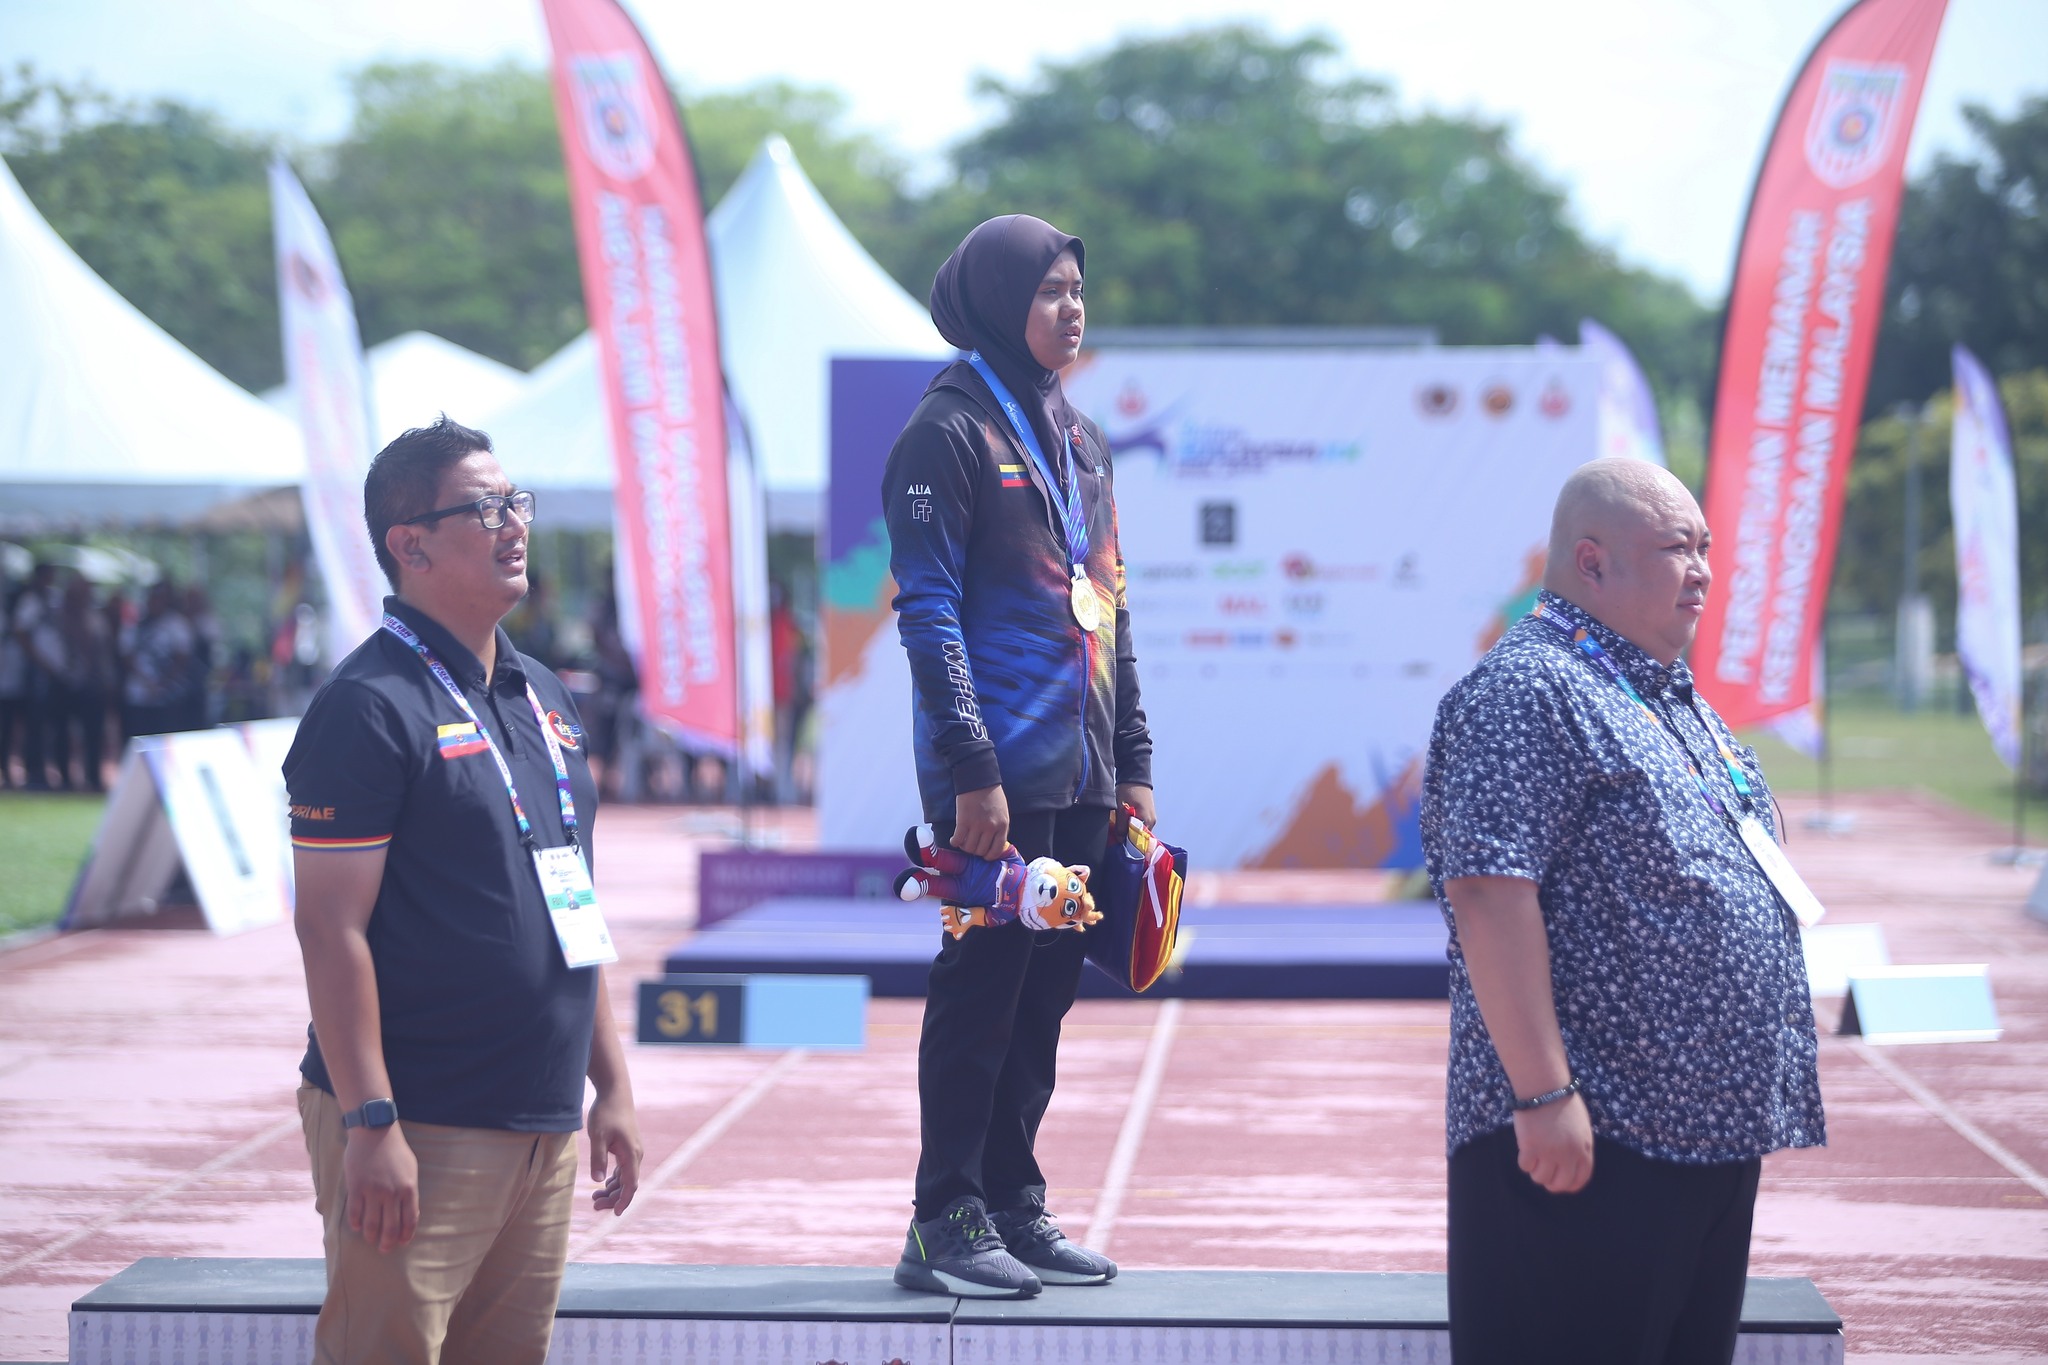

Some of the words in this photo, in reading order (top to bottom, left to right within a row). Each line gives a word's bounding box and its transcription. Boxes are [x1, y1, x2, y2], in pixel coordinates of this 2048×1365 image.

[1805, 198, 1873, 412] MALAYSIA
[907, 484, 932, 495] ALIA
[1717, 428, 1786, 683] PERSATUAN
[655, 990, 719, 1037] 31
